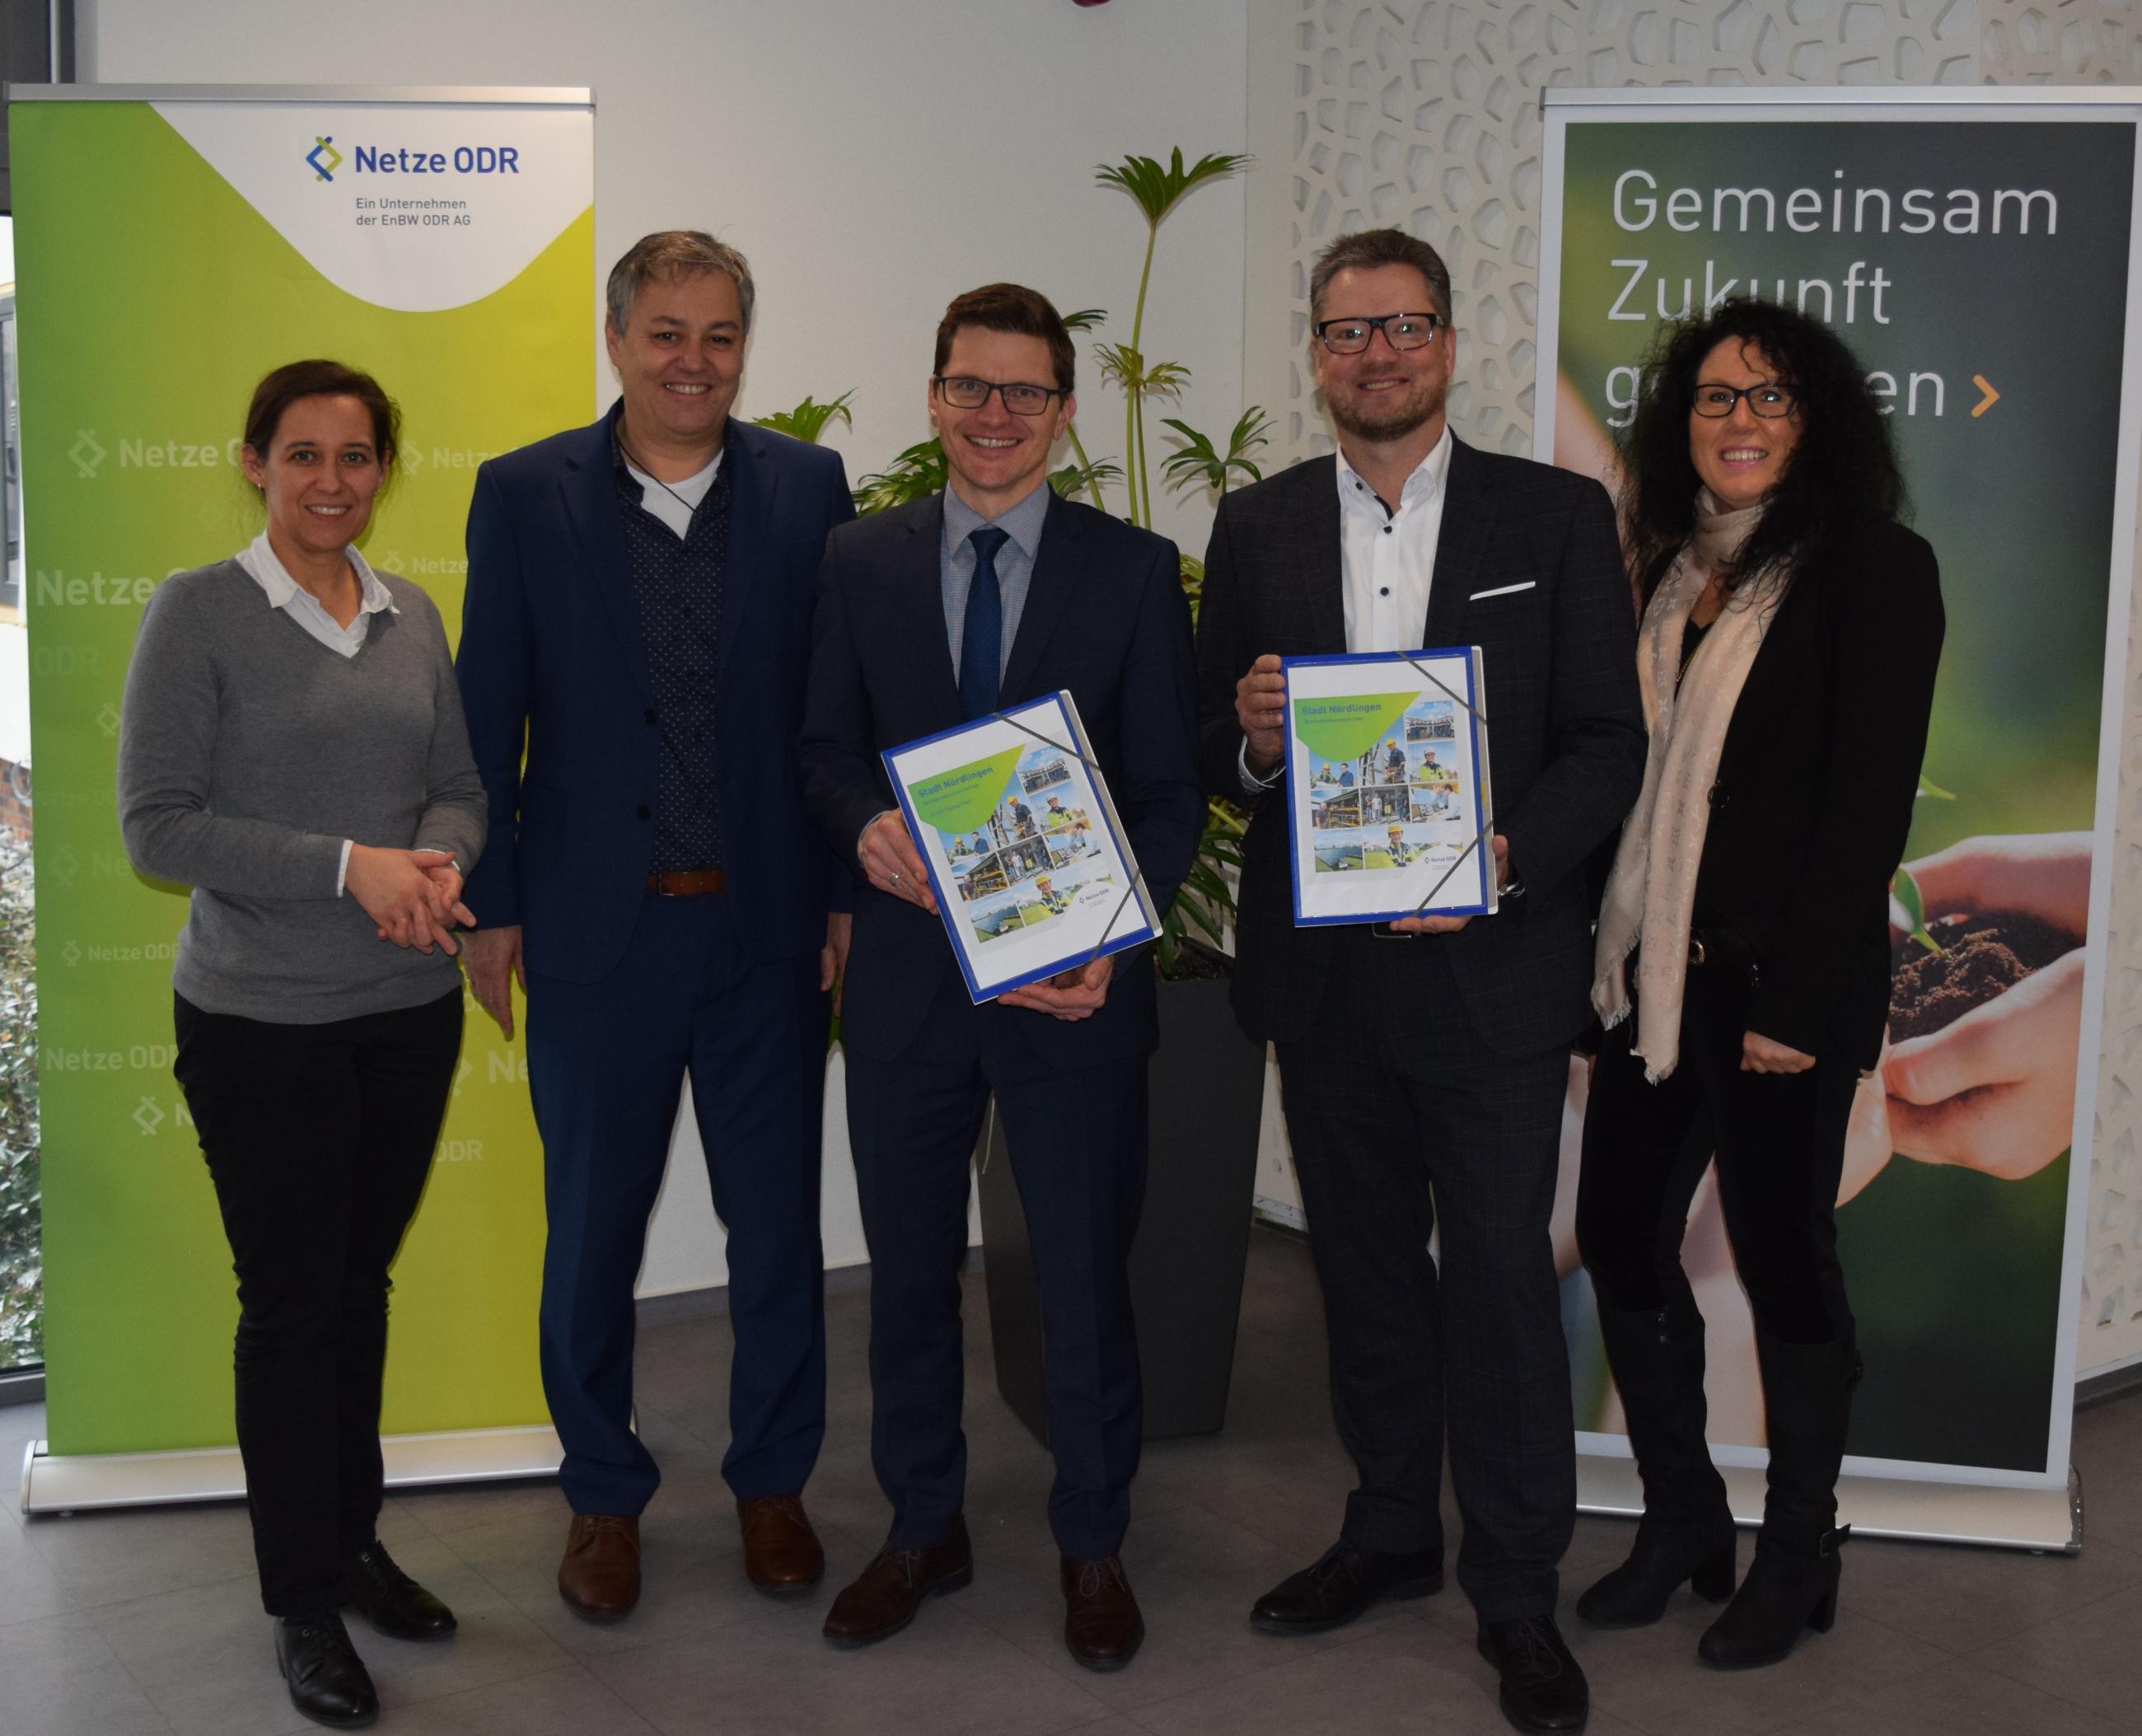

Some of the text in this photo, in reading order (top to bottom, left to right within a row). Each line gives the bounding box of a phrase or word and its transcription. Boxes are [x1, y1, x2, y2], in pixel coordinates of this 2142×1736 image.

[356, 146, 519, 173] Netze ODR
[356, 198, 467, 209] Ein Unternehmen
[1612, 168, 2058, 236] Gemeinsam
[356, 214, 471, 226] der EnBW ODR AG
[119, 437, 221, 469] Netze
[35, 568, 157, 606] Netze
[1302, 703, 1382, 715] Stadt Nördlingen
[918, 783, 943, 798] Stadt
[942, 766, 994, 788] Nördlingen
[87, 943, 142, 962] Netze
[44, 1046, 124, 1071] Netze
